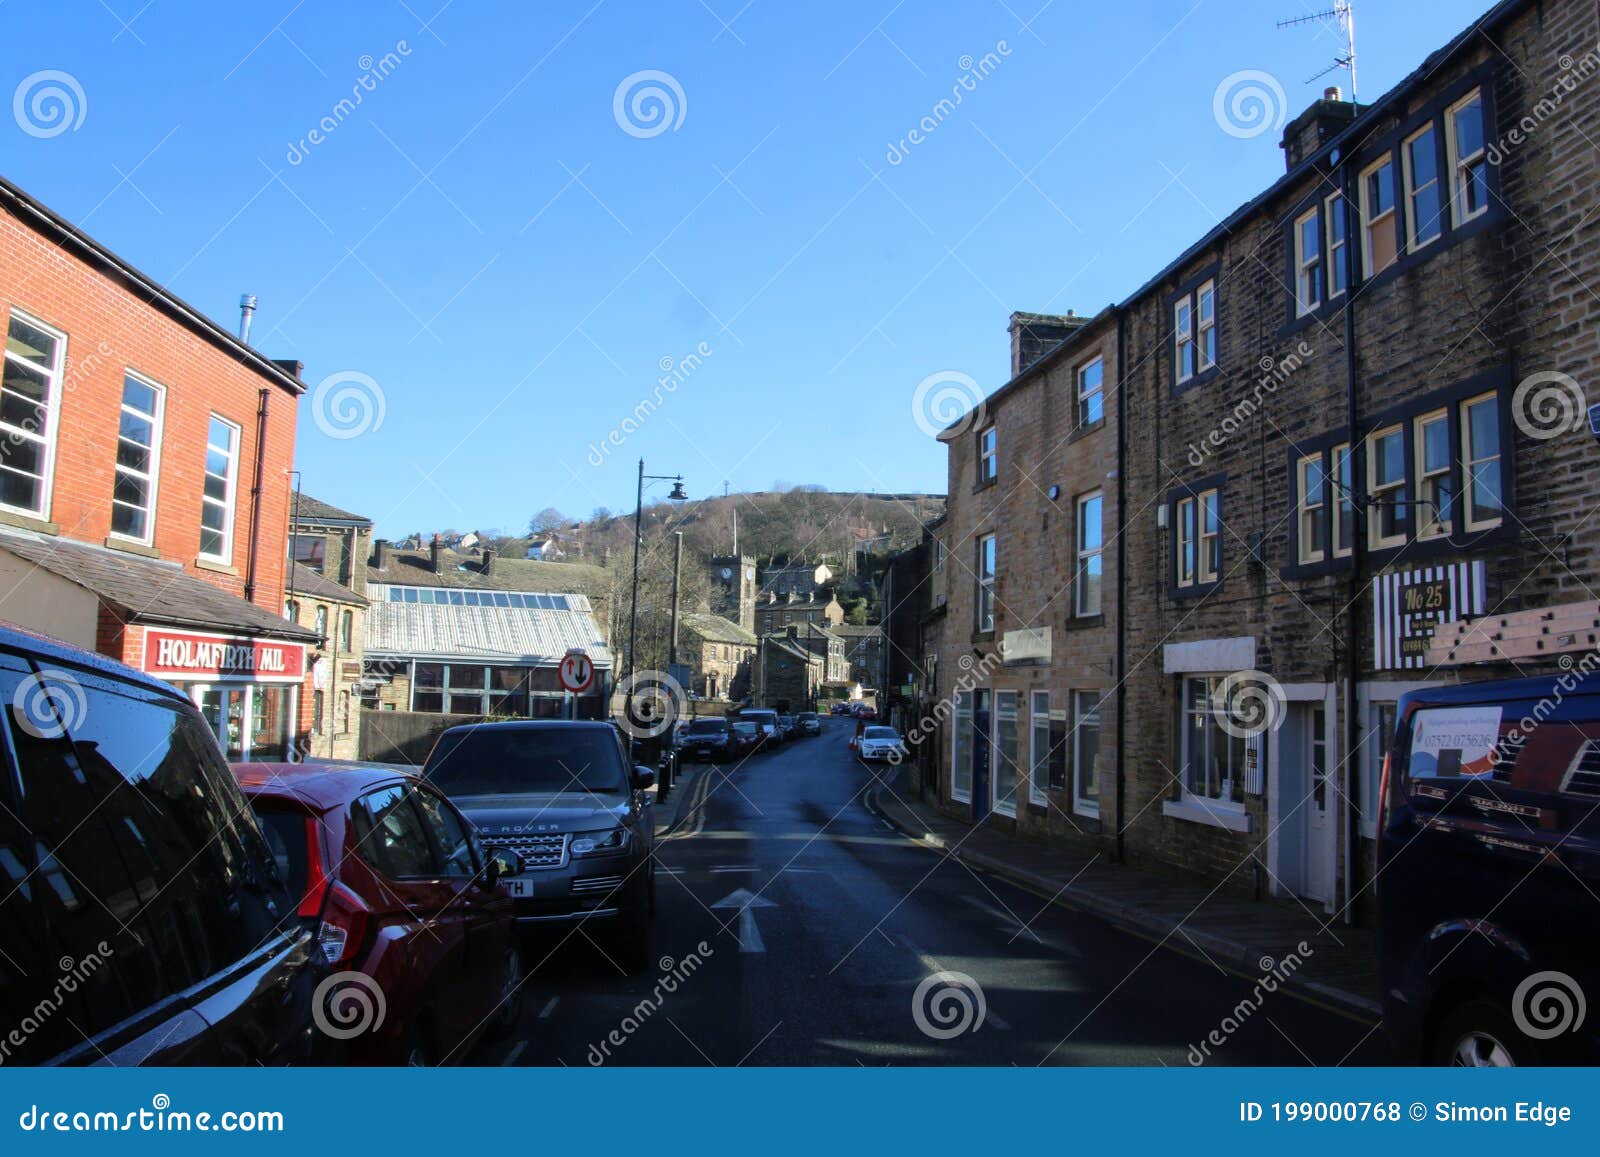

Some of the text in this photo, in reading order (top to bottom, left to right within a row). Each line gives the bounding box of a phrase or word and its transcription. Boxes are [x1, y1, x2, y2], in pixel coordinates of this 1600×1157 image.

[1405, 585, 1443, 611] No 25
[157, 638, 285, 671] HOLMFIRTH MIL
[501, 824, 559, 832] ROVER
